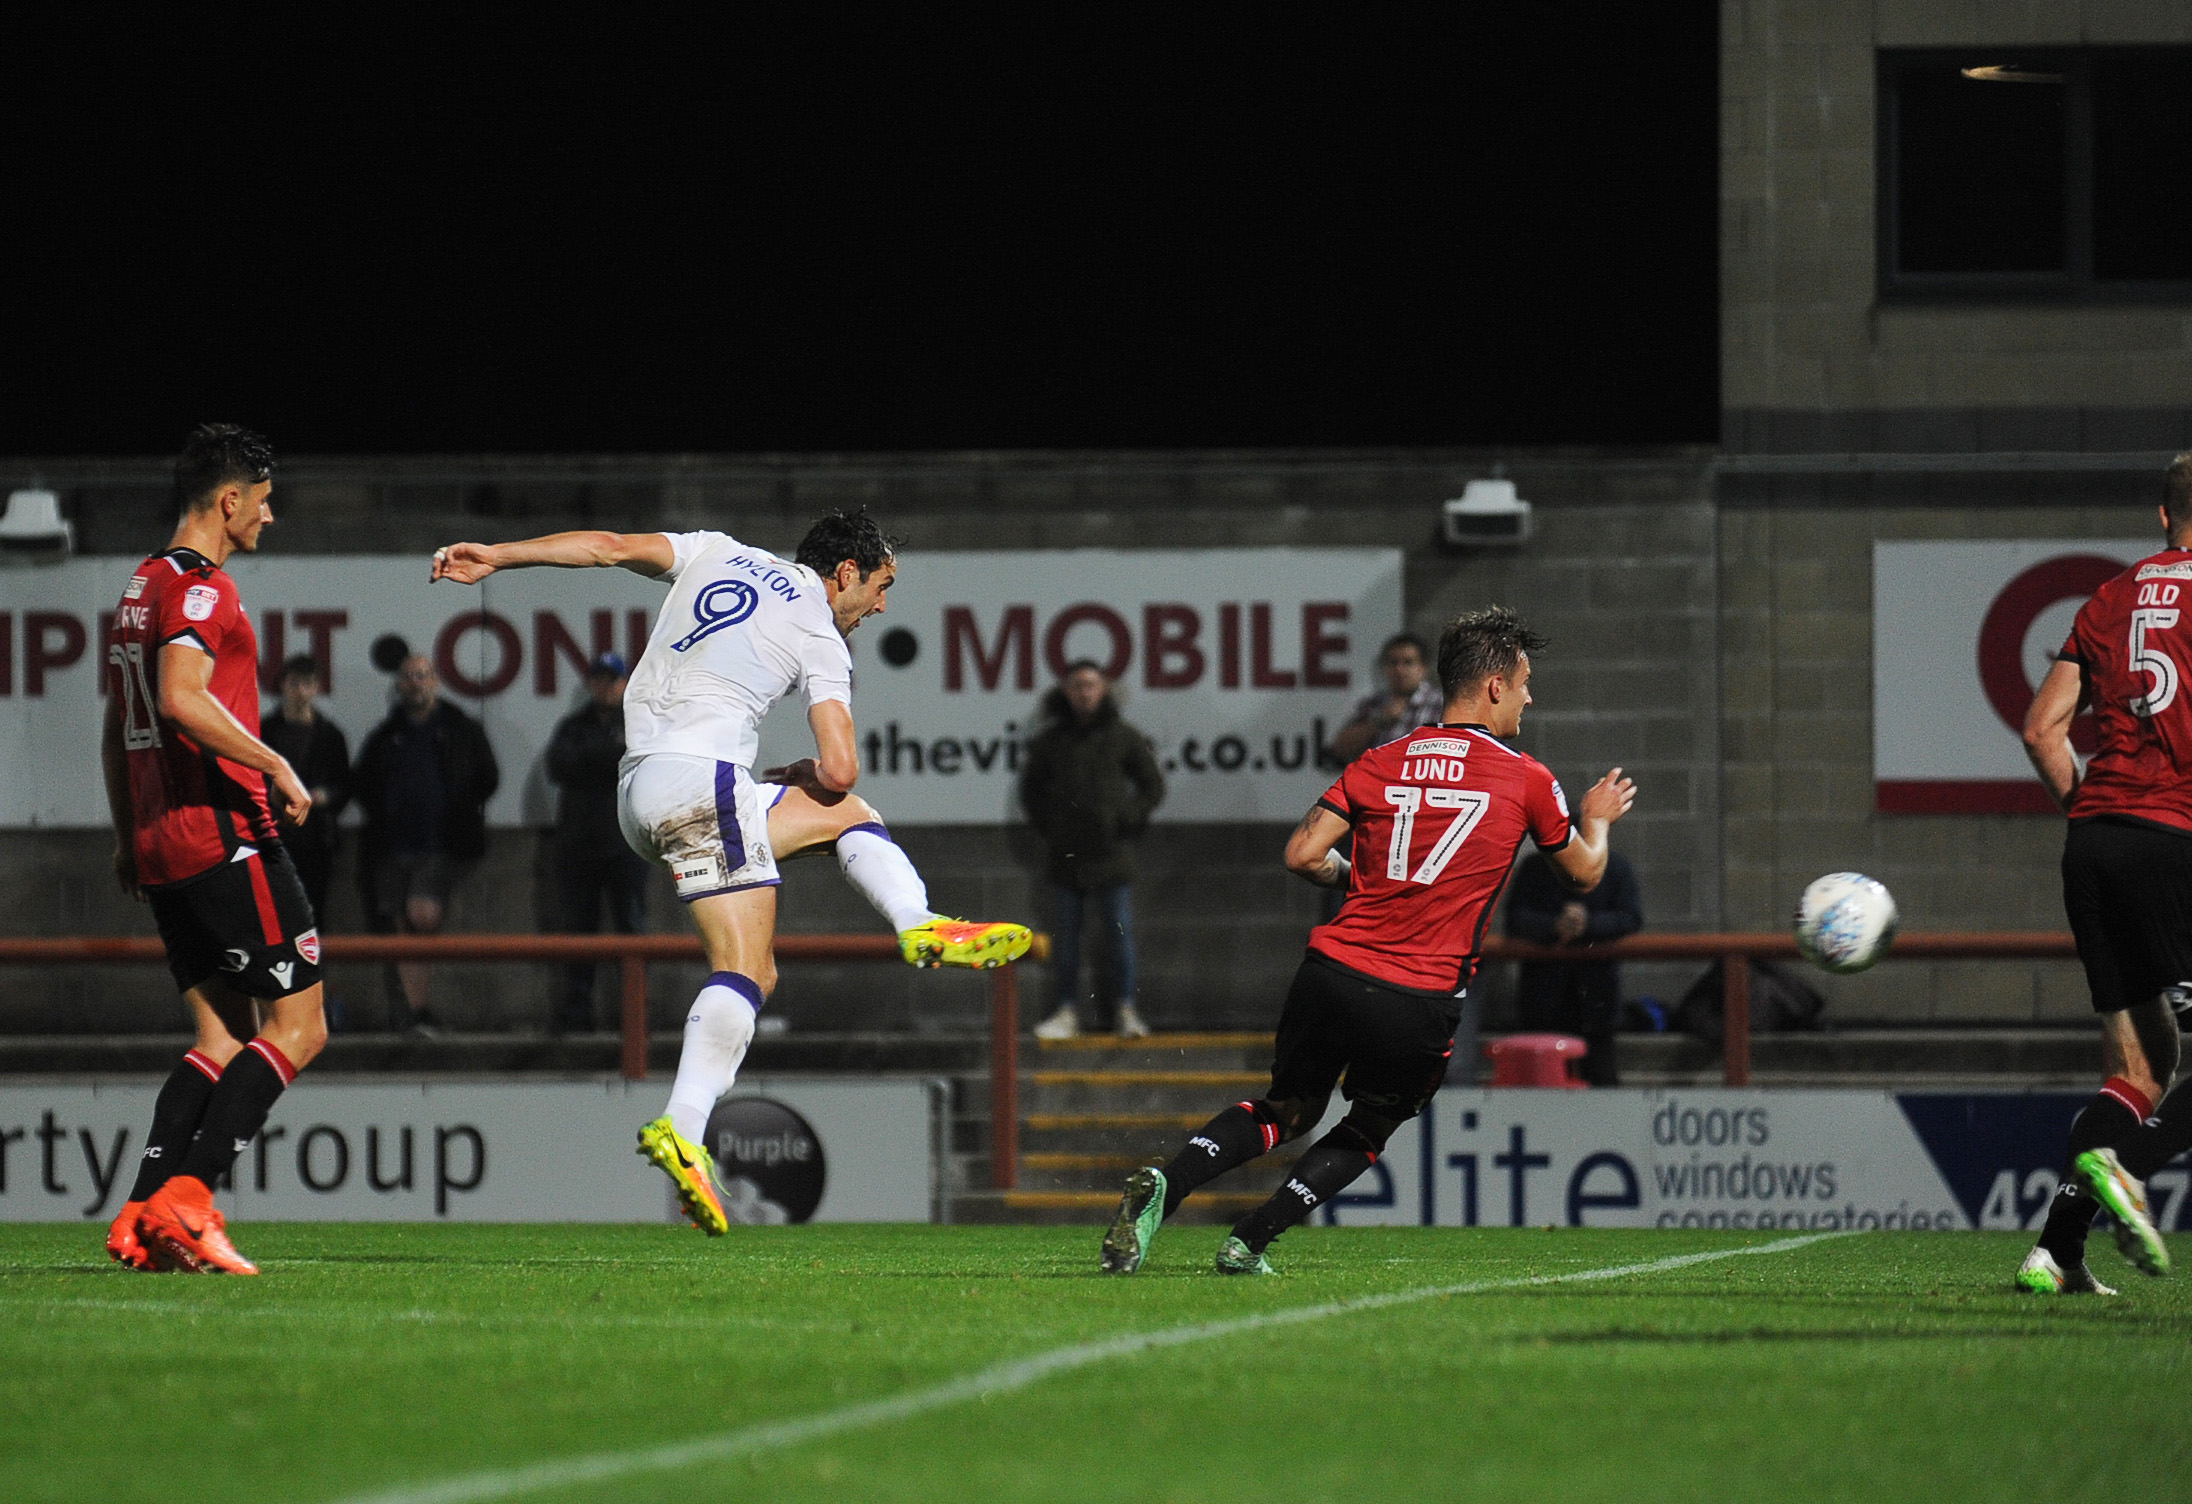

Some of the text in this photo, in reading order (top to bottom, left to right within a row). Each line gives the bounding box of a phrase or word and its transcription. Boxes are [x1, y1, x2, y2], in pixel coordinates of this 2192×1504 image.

[725, 555, 802, 602] HYLTON
[2137, 583, 2180, 606] OLD
[670, 579, 759, 653] 9
[943, 602, 1350, 692] MOBILE
[2128, 608, 2180, 717] 5
[1408, 741, 1467, 753] DENNISON
[1400, 758, 1465, 782] LUND
[1384, 785, 1491, 885] 17
[1653, 1100, 1770, 1146] doors
[143, 1145, 162, 1158] FC
[717, 1130, 811, 1167] Purple
[1188, 1136, 1220, 1157] MFC
[217, 1124, 486, 1216] roup
[1654, 1152, 1838, 1200] windows
[2057, 1183, 2078, 1197] FC
[1287, 1178, 1317, 1205] MFC
